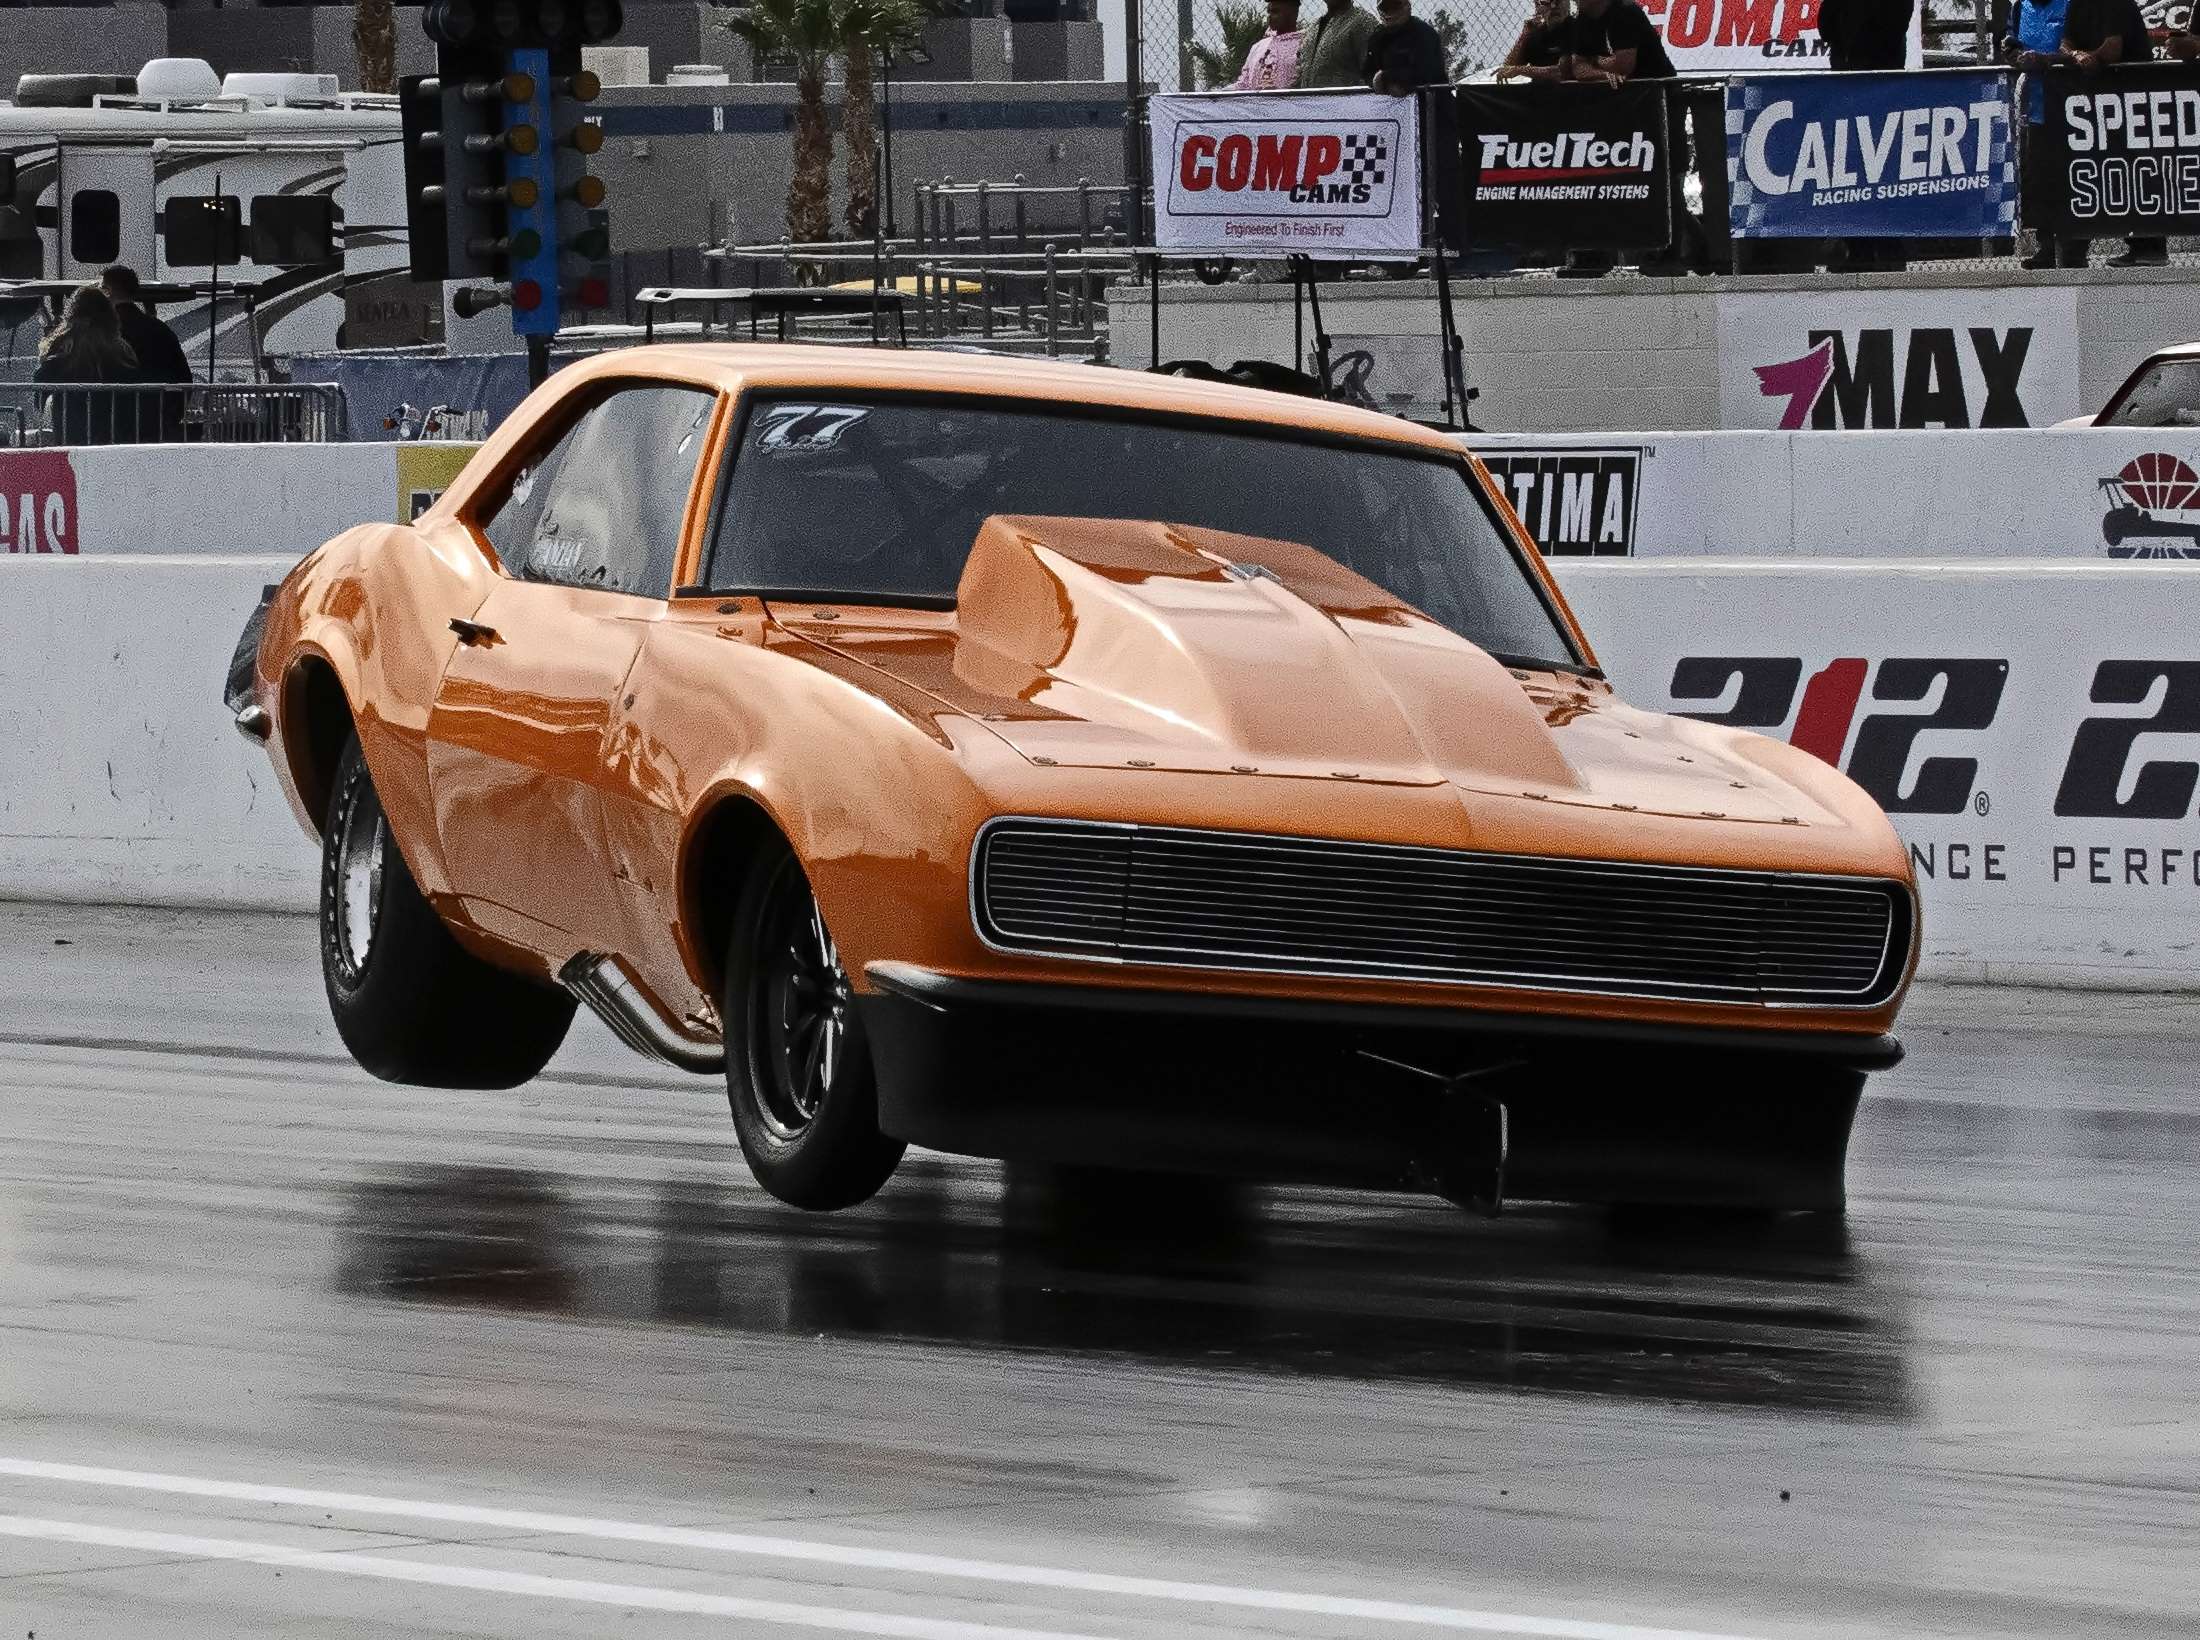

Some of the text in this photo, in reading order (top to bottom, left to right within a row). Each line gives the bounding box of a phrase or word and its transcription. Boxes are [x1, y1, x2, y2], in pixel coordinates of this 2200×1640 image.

[2065, 90, 2200, 150] SPEED
[1179, 134, 1342, 192] COMP
[1477, 131, 1655, 172] FuelTech
[1744, 100, 2004, 195] CALVERT
[1289, 183, 1371, 204] CAMS
[1475, 184, 1650, 200] ENGINE MANAGEMENT SYSTEMS
[1812, 174, 1990, 206] RACING SUSPENSIONS
[1224, 221, 1344, 238] Engineered To Finish First
[757, 404, 871, 450] 77
[2053, 845, 2200, 887] PERF
